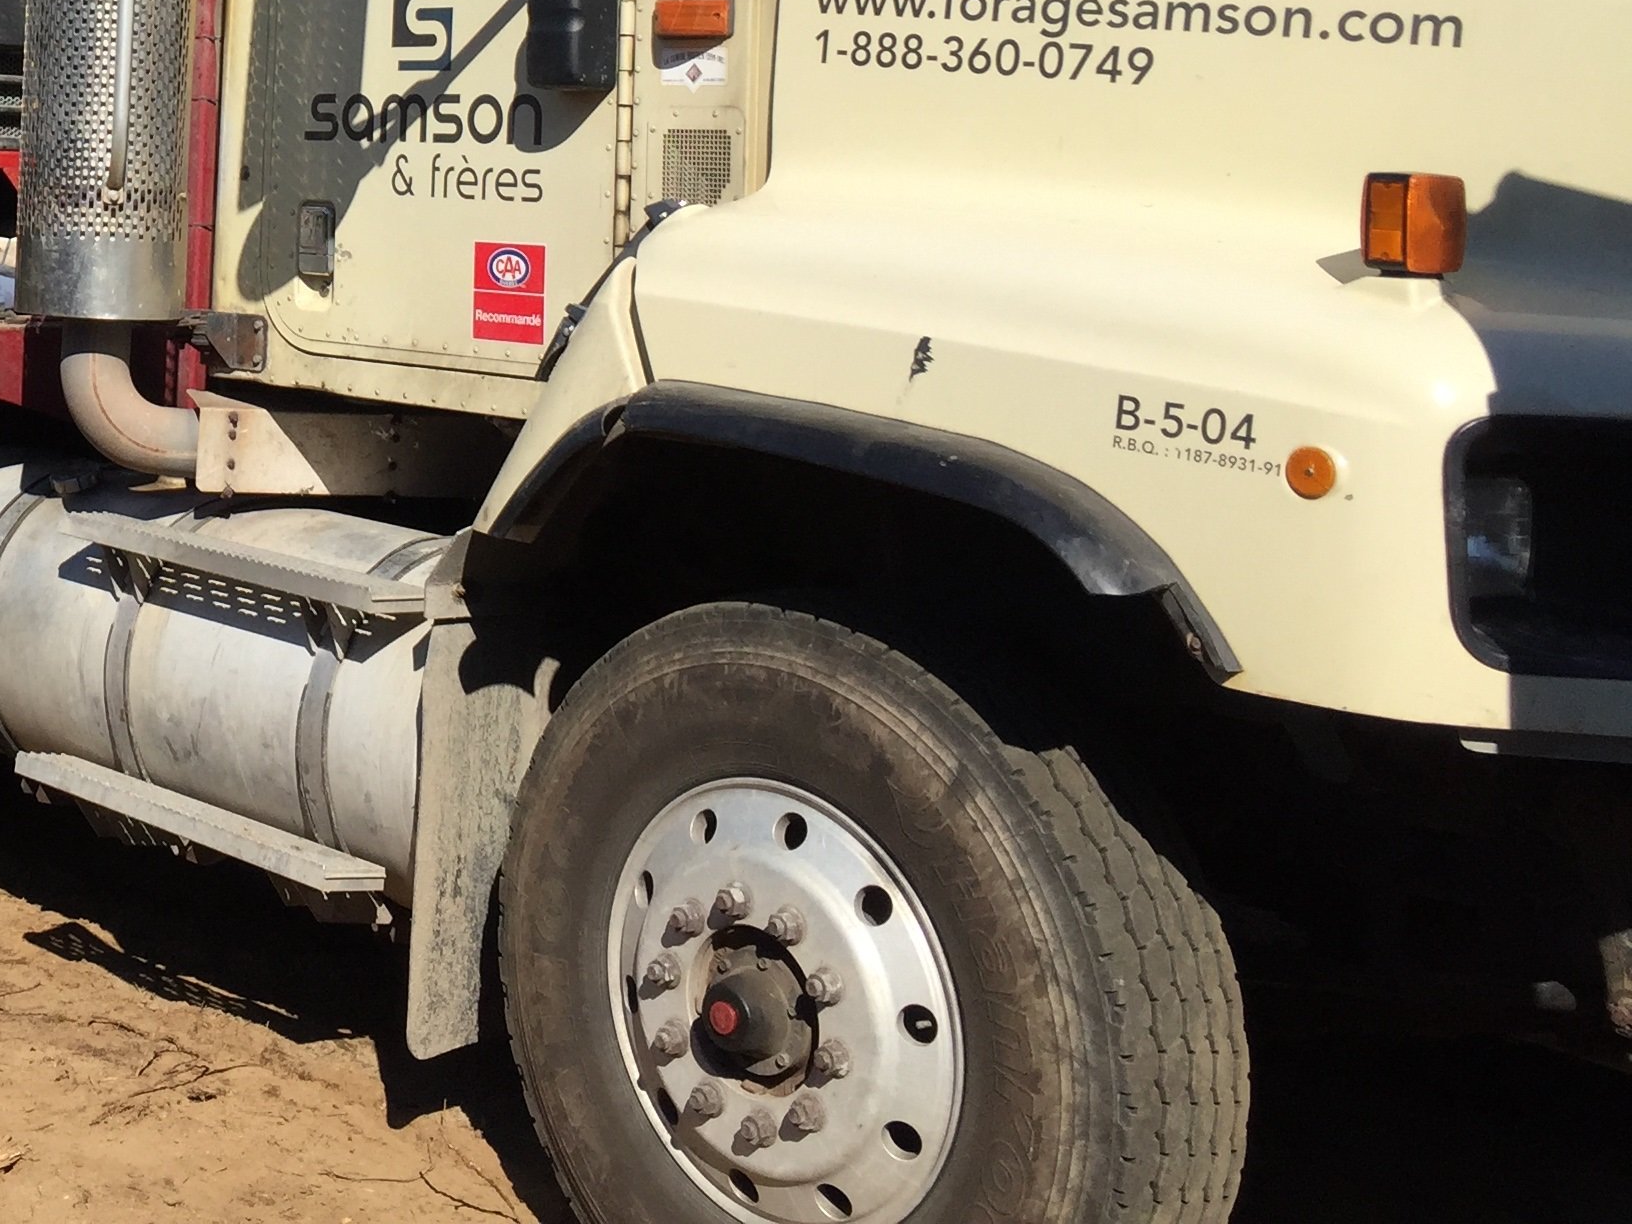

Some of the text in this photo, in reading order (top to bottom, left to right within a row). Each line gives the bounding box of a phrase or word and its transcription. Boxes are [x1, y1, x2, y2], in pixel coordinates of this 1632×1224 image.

[813, 28, 1155, 86] 1-888-360-0749
[304, 93, 543, 146] samson
[391, 152, 543, 203] & frères
[496, 256, 522, 279] CAA
[475, 309, 542, 327] Recommandé
[1112, 435, 1159, 456] R.B.Q.
[1114, 393, 1257, 450] B-5-04
